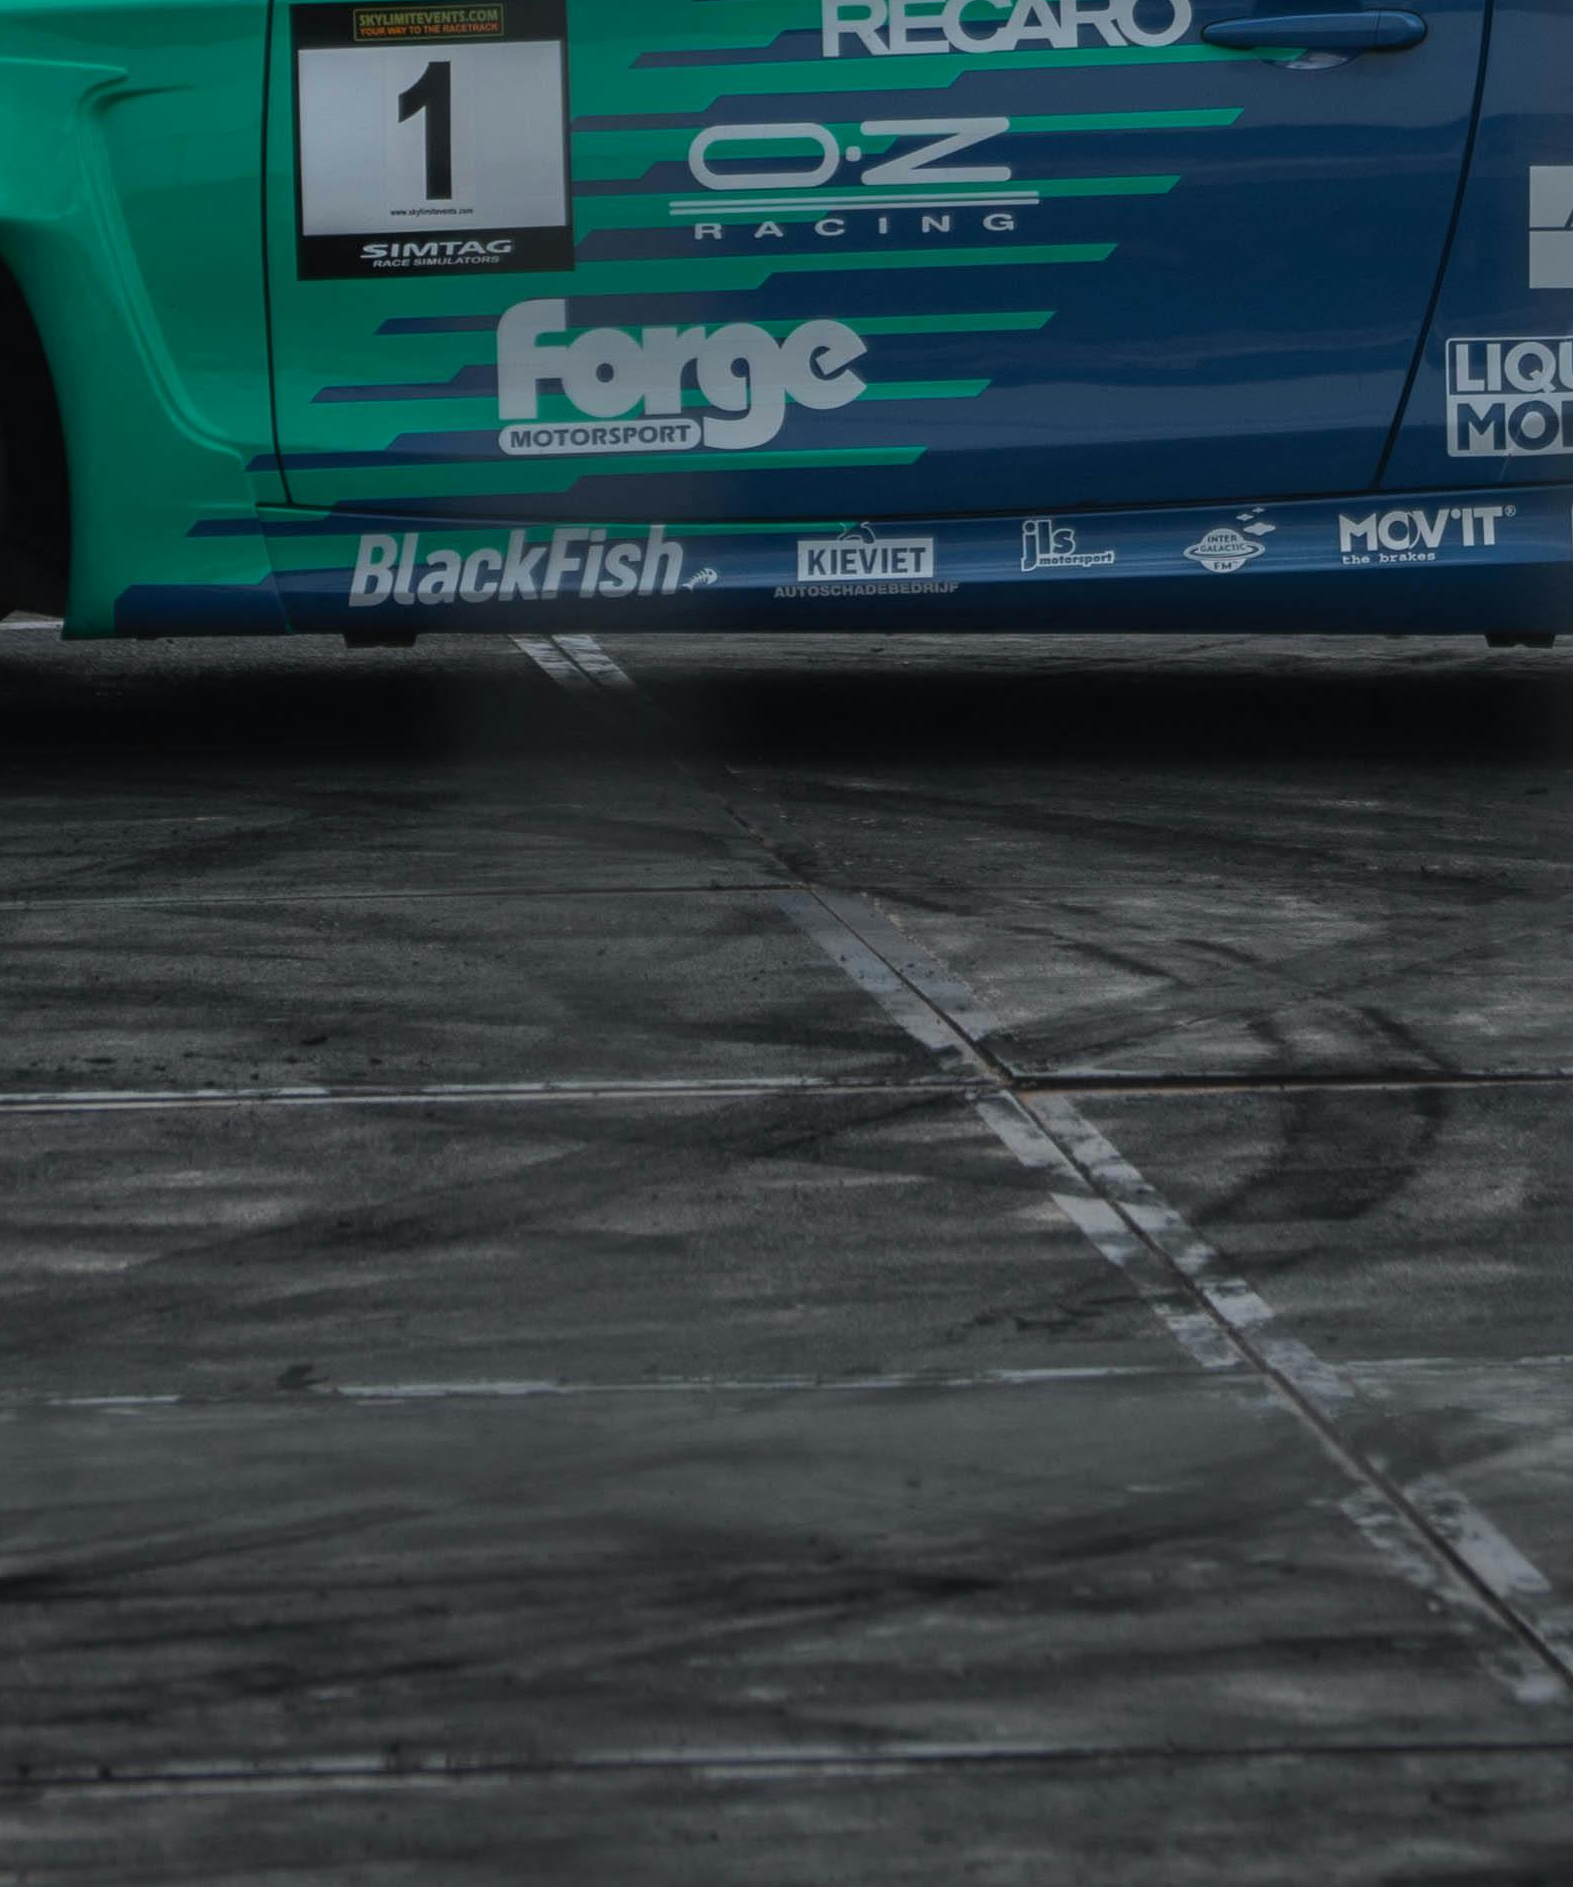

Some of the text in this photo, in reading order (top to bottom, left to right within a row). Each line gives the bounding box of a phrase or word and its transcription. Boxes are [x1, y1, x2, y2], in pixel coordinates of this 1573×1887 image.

[359, 9, 498, 27] SKYLIMITEVENTS.COM
[359, 21, 499, 36] YOUR WAY TO THE RACETRACK
[398, 61, 452, 200] 1
[694, 213, 1015, 240] RACING
[360, 240, 512, 259] SIMTAG
[373, 255, 500, 268] RACE SIMULATORS
[497, 298, 868, 450] forge
[510, 424, 692, 449] MOTORSPORT
[1021, 519, 1077, 571] jls
[1207, 534, 1237, 543] INTER
[1200, 543, 1247, 553] GALACTIC
[348, 524, 684, 607] BlackFish
[807, 545, 927, 576] KIEVIET
[1039, 554, 1113, 567] motorsport
[1342, 551, 1437, 564] the brakes
[773, 581, 960, 599] AUTOSCHADEBEDRIJF
